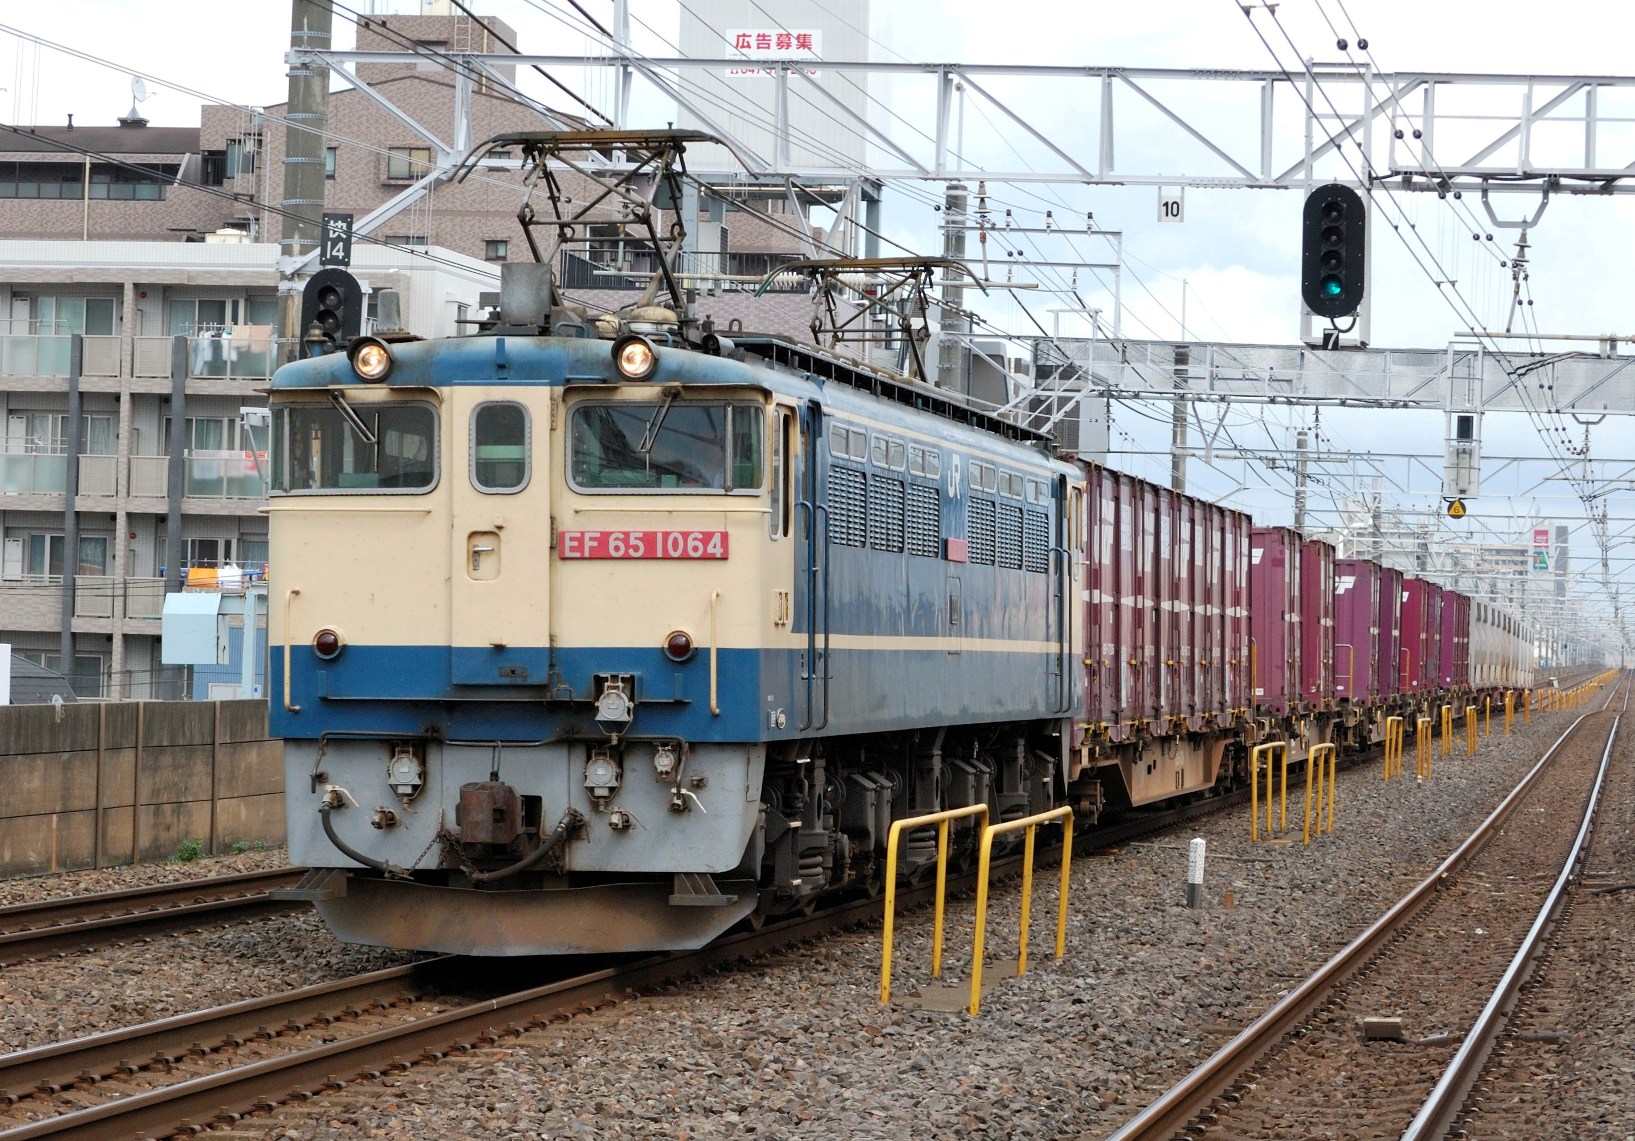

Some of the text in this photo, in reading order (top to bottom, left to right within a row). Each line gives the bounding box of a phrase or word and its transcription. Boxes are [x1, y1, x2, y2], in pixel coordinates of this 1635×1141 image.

[735, 33, 813, 50] 広告募集
[1162, 200, 1180, 217] 10
[326, 241, 345, 260] 14
[1324, 329, 1339, 350] 7
[947, 453, 961, 500] JR
[1453, 505, 1461, 514] 6
[564, 532, 724, 558] EF 65 1064
